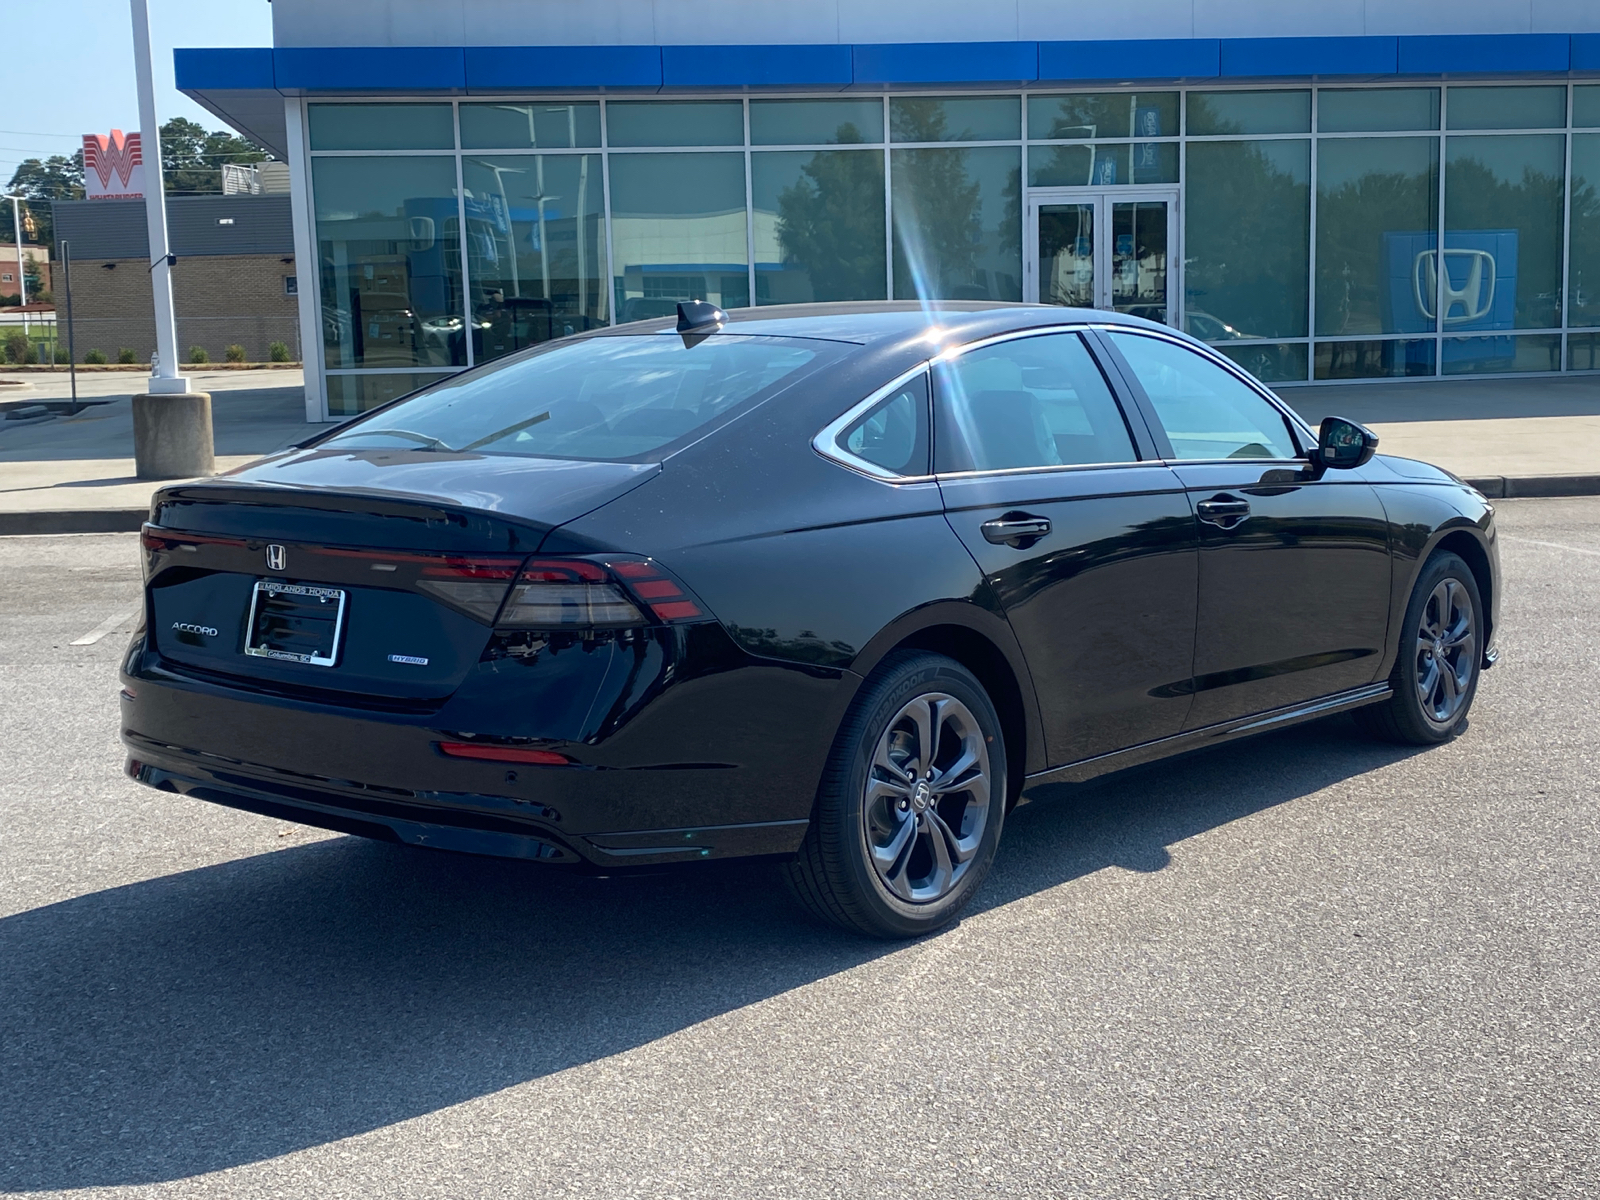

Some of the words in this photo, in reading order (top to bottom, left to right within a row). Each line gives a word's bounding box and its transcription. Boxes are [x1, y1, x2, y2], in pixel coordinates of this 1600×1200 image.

[264, 583, 306, 594] MIDLANDS
[309, 587, 339, 598] HONDA
[171, 621, 218, 637] ACCORD
[300, 655, 310, 663] SC
[393, 655, 426, 664] HYBRID
